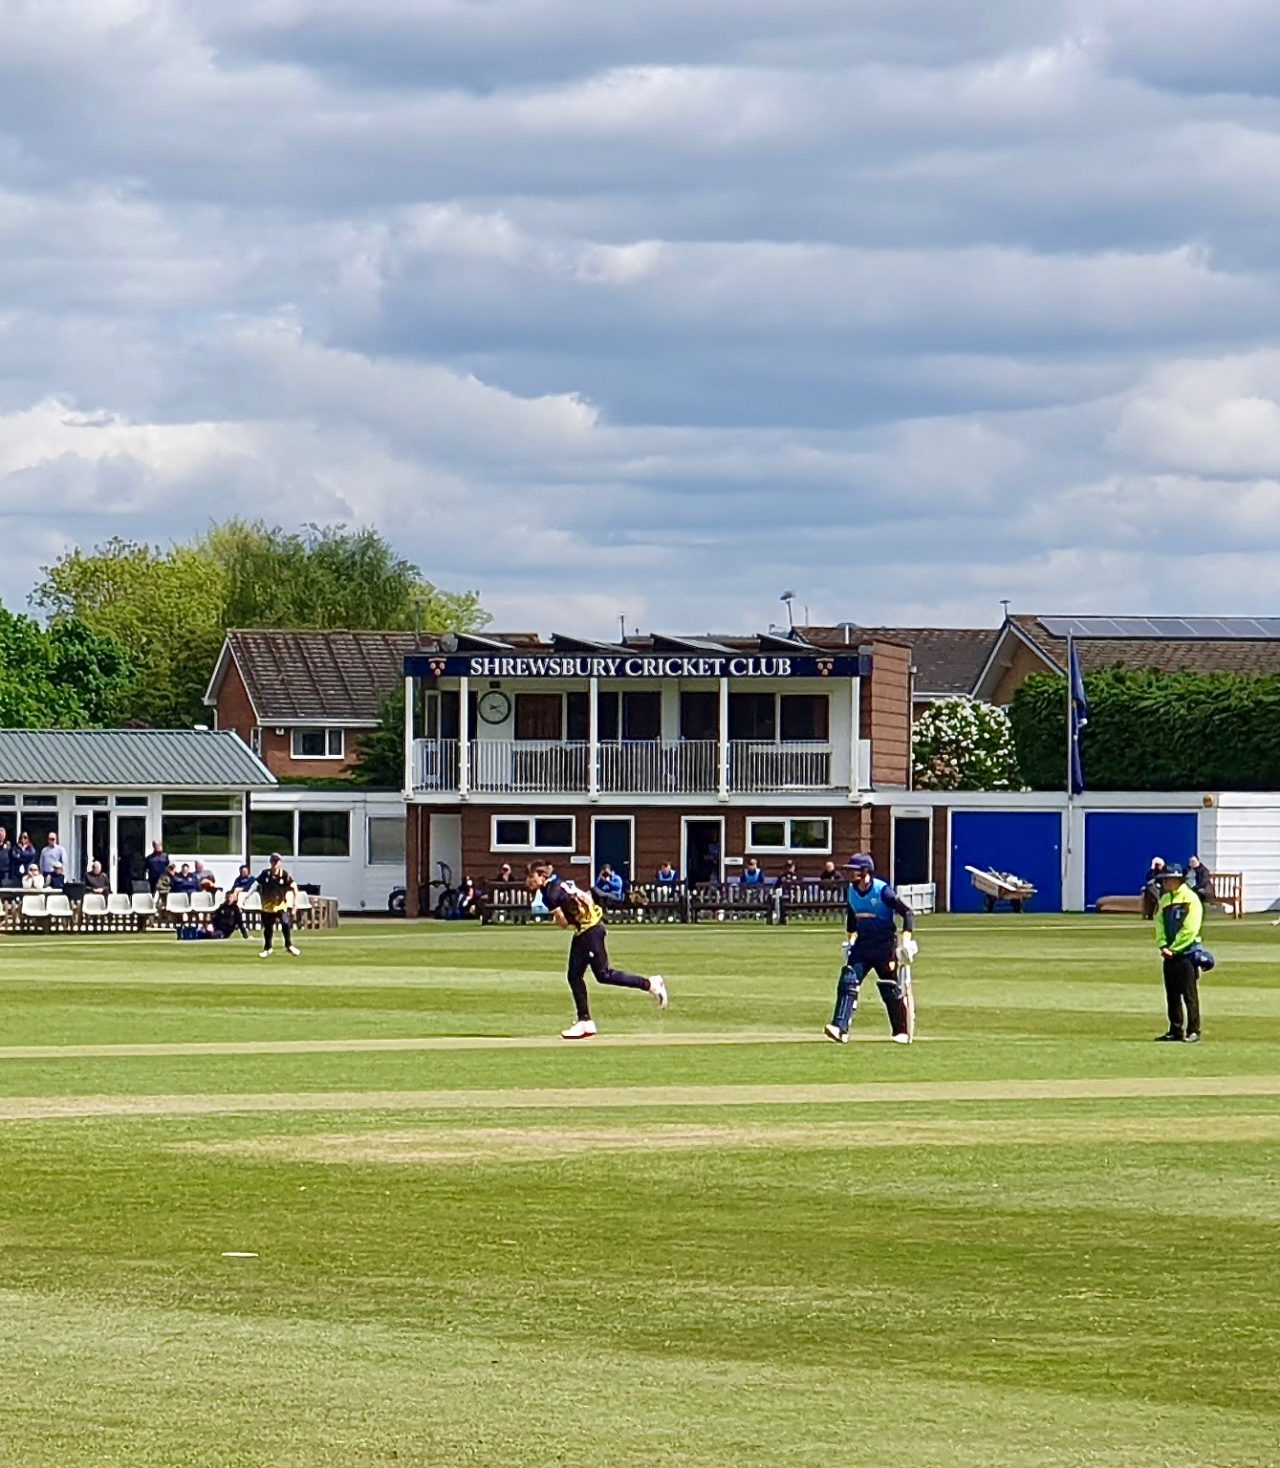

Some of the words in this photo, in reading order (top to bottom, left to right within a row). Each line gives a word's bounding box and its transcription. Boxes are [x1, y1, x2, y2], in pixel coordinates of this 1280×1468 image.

[470, 658, 621, 676] SHREWSBURY
[624, 658, 725, 676] CRICKET
[729, 658, 792, 676] CLUB
